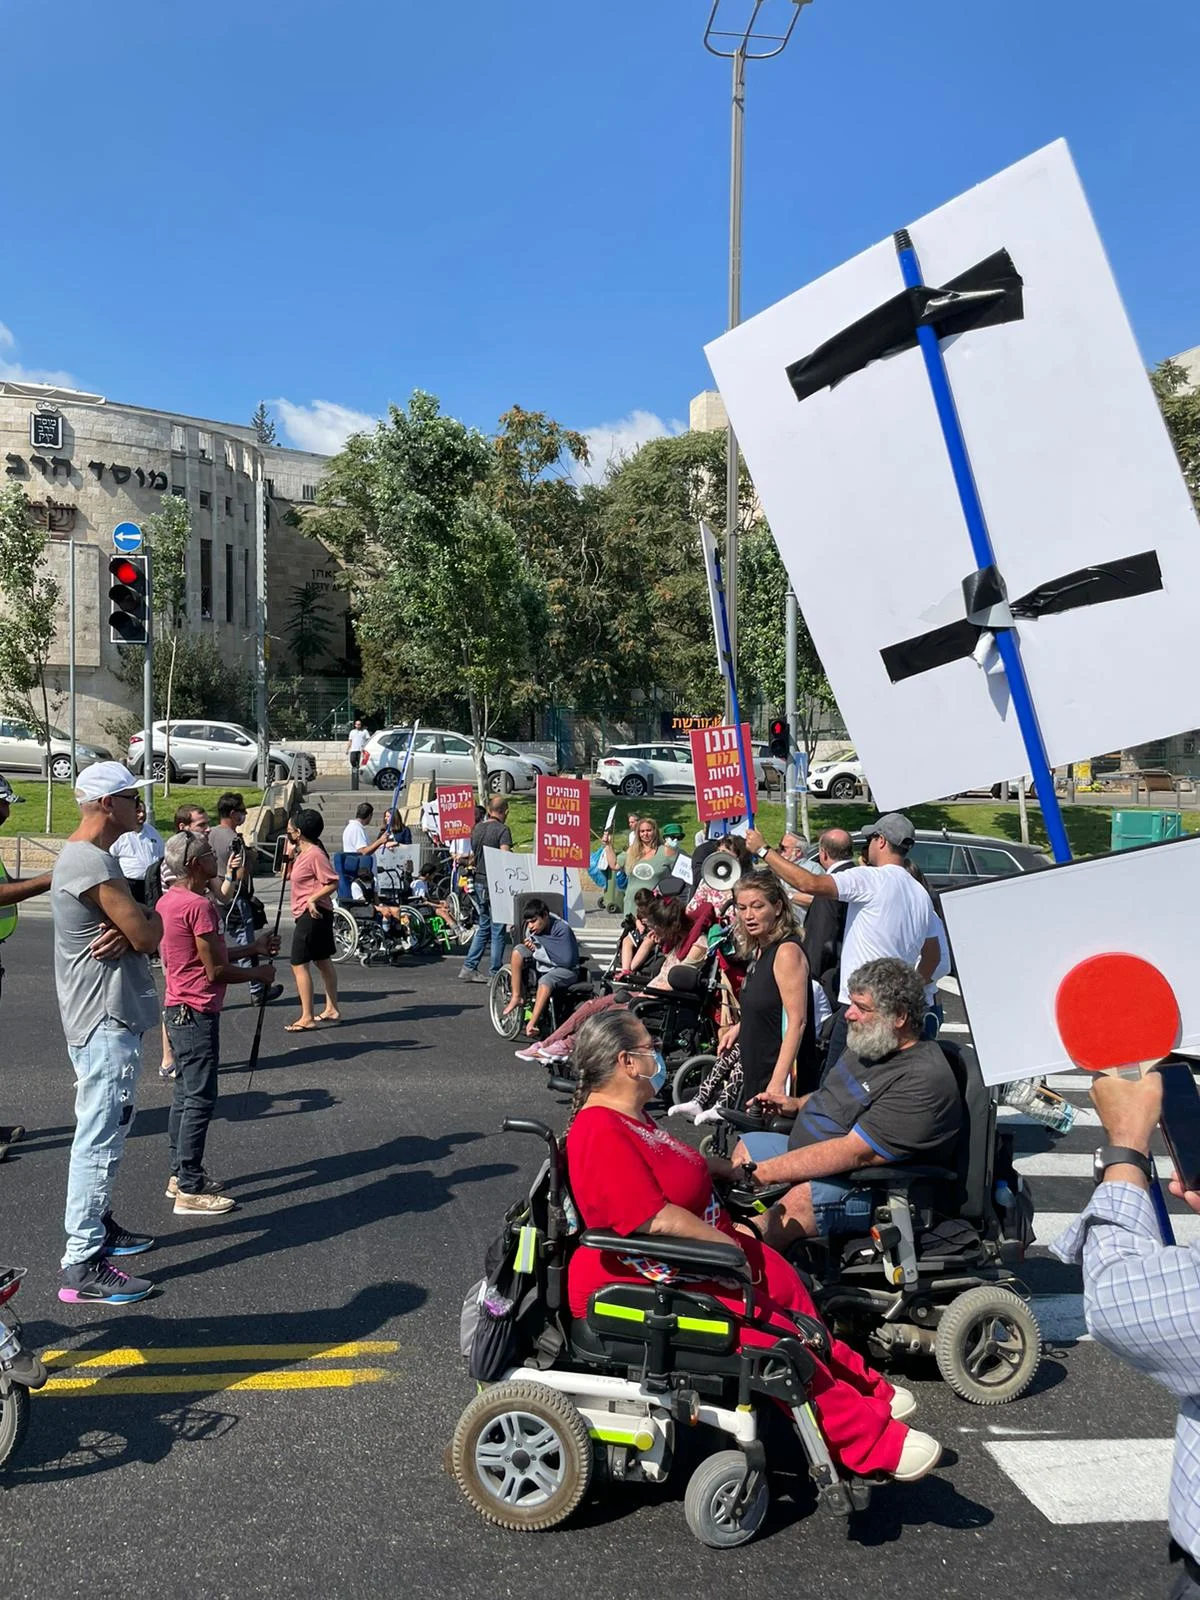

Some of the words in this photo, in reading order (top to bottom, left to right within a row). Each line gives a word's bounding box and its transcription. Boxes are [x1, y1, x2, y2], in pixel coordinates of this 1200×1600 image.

[36, 417, 56, 426] מוסד
[39, 432, 54, 442] קוק
[5, 452, 71, 477] הרב
[88, 460, 168, 490] מוסד
[704, 729, 738, 752] תנו
[708, 763, 740, 780] לחיות
[440, 793, 456, 803] נכה
[457, 790, 472, 802] ילד
[546, 786, 580, 798] מנהיגים
[703, 785, 733, 800] הורה
[444, 820, 462, 829] הורה
[546, 812, 580, 826] חלשים
[544, 833, 571, 847] הורה
